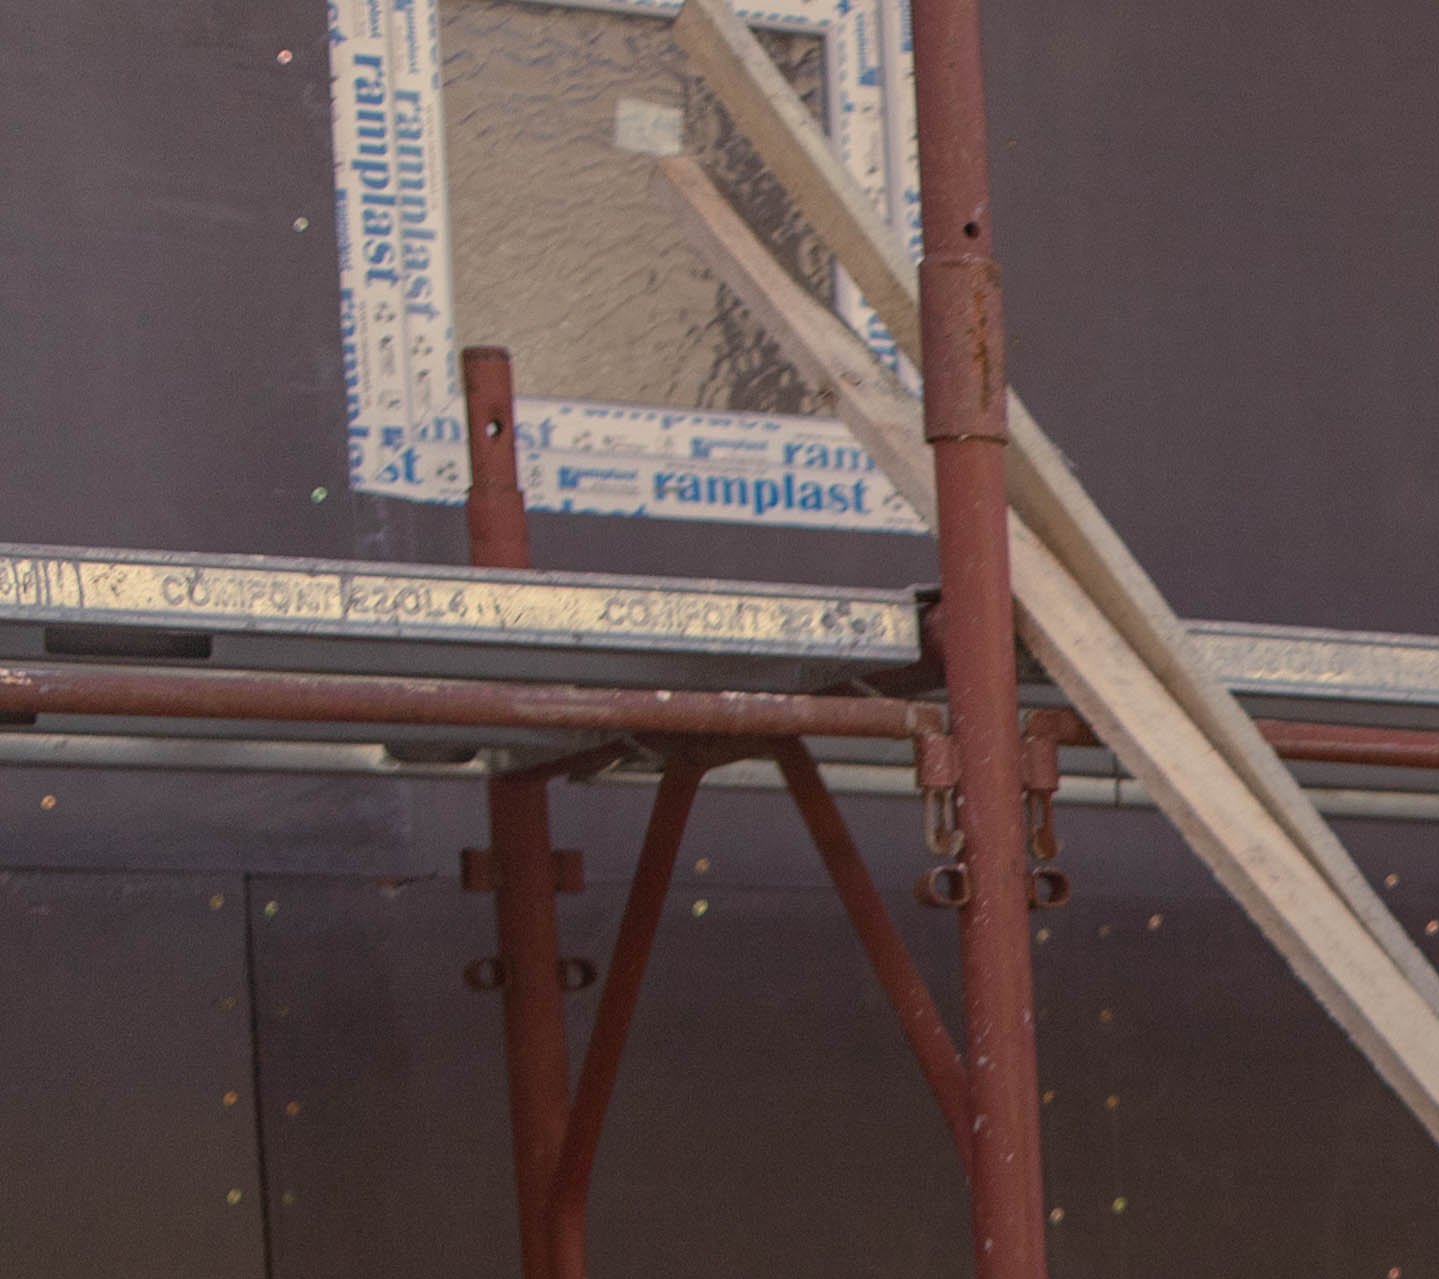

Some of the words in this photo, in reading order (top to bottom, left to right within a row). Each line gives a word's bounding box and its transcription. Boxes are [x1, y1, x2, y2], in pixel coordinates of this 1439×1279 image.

[351, 54, 400, 288] ramplast
[394, 90, 440, 321] ramplast
[653, 470, 872, 516] ramplast
